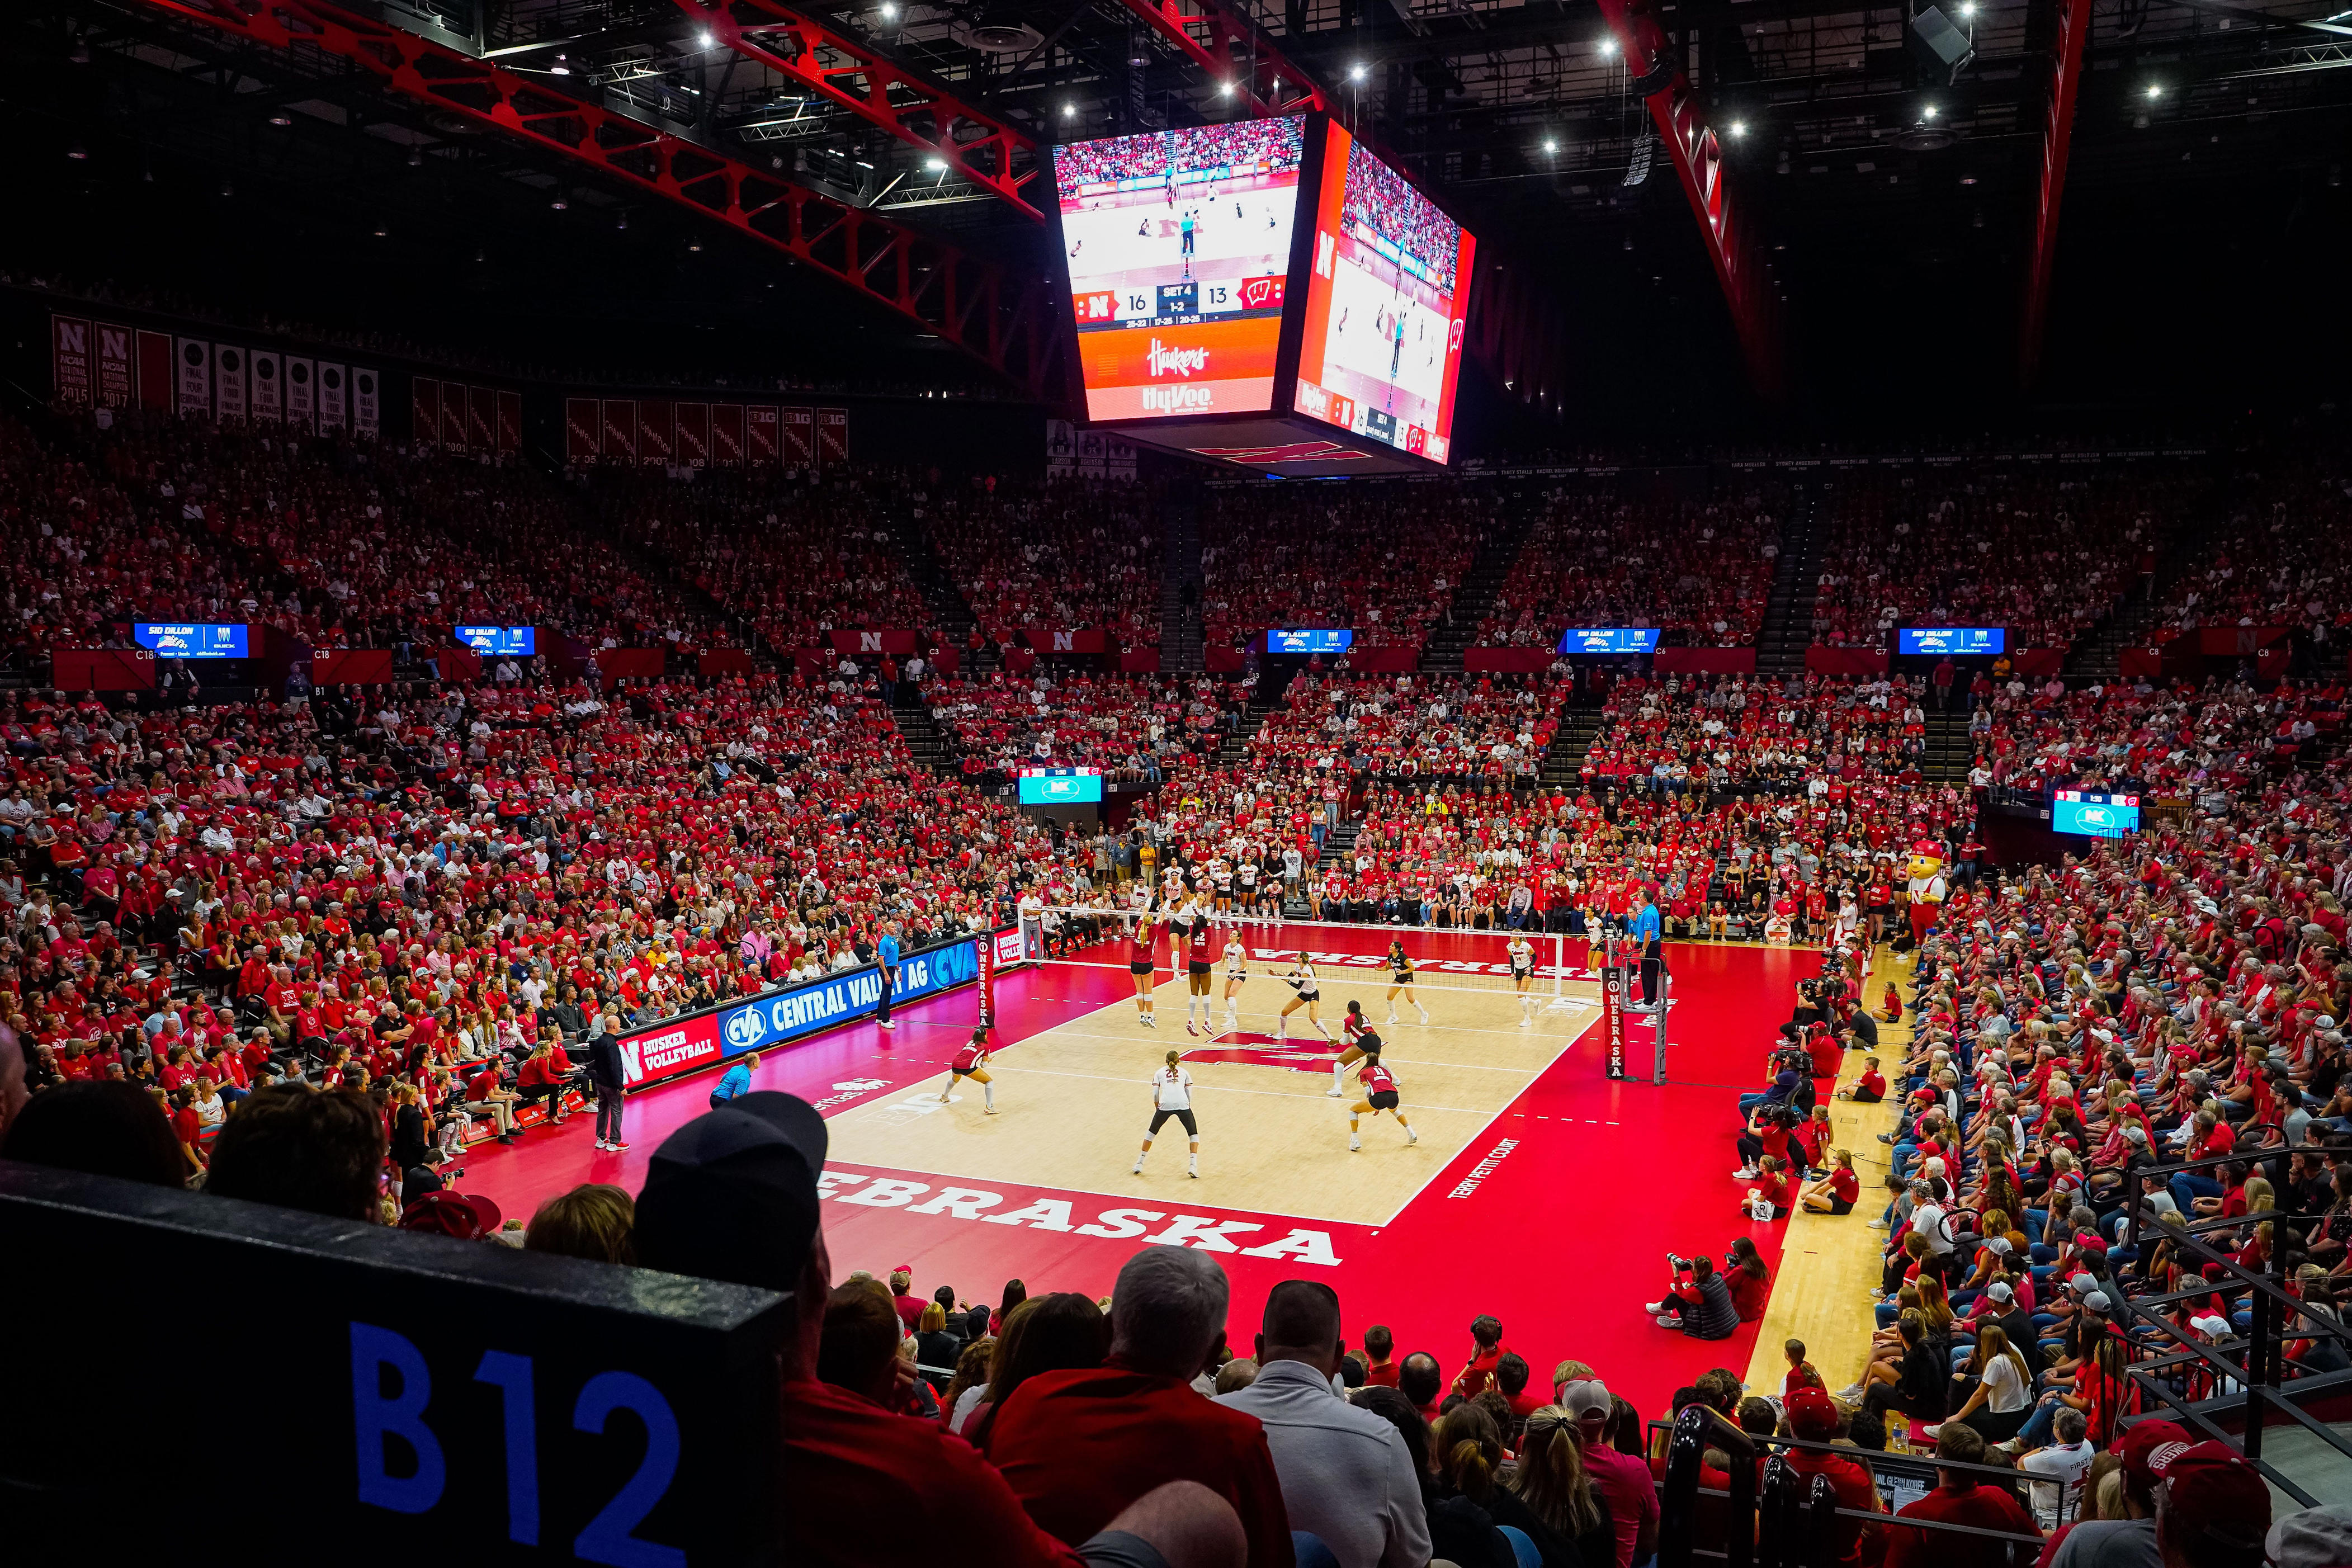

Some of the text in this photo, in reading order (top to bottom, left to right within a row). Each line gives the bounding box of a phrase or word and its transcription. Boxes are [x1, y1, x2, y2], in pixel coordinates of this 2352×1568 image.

[1163, 285, 1192, 297] SET 4
[1210, 287, 1227, 304] 13
[1089, 295, 1109, 318] N
[1129, 295, 1146, 311] 16
[1170, 301, 1184, 312] 1-2
[59, 322, 85, 354] N
[102, 328, 127, 360] N
[59, 354, 85, 366] NCAA
[1147, 337, 1210, 377] Huskers
[61, 386, 87, 403] 2015
[164, 626, 193, 635] DILLON
[861, 632, 882, 651] N
[1054, 632, 1073, 650] N
[315, 650, 330, 659] C18
[2257, 649, 2269, 657] C8
[315, 687, 324, 696] B1
[1911, 890, 1924, 905] N
[999, 933, 1020, 949] HUSKE
[772, 986, 847, 1031] CENTRAL
[908, 960, 928, 990] AG
[979, 954, 988, 1026] NEBRASKA
[643, 1031, 687, 1056] HUSKER
[1609, 995, 1622, 1076] NEBRASKA
[644, 1038, 715, 1071] VOLLEYBALL
[1447, 1137, 1520, 1198] TERRY PETTIT COURT
[819, 1170, 1343, 1267] EBRASKA
[350, 1321, 687, 1568] B12
[2069, 1458, 2088, 1471] FIRST
[1875, 1473, 1886, 1486] UNL
[1906, 1479, 1925, 1491] KORFF
[1877, 1488, 1893, 1500] CHOO
